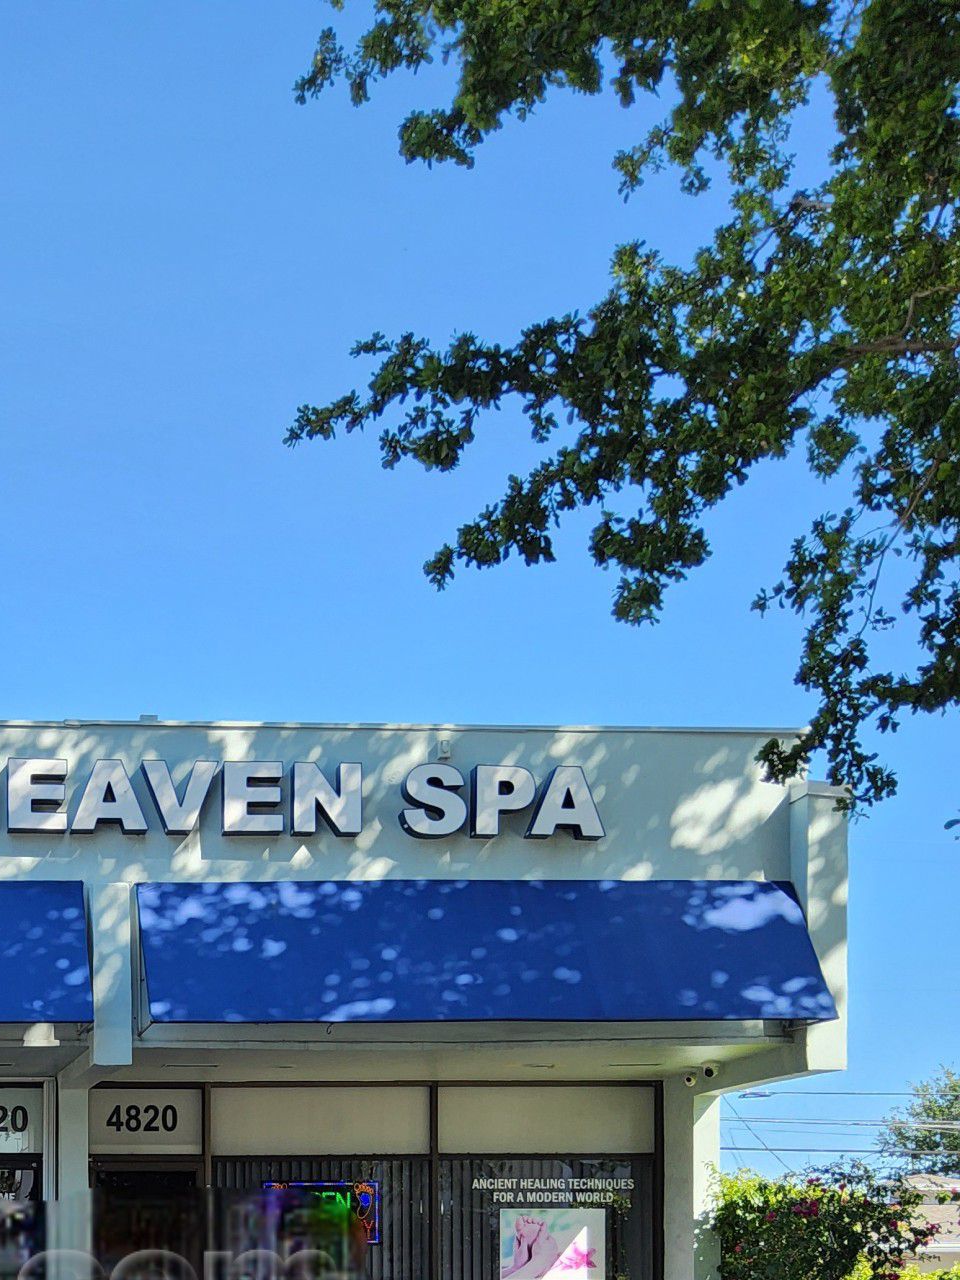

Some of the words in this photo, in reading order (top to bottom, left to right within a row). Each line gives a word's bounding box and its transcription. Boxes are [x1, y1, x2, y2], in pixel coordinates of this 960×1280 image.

[401, 762, 607, 841] SPA
[106, 1104, 179, 1133] 4820
[471, 1178, 517, 1190] ANCIENT
[520, 1178, 566, 1190] HEALING
[568, 1178, 635, 1191] TECHNIQUES
[493, 1192, 514, 1203] FOR
[516, 1192, 525, 1203] A
[527, 1192, 573, 1203] MODERN
[576, 1192, 614, 1203] WORLD
